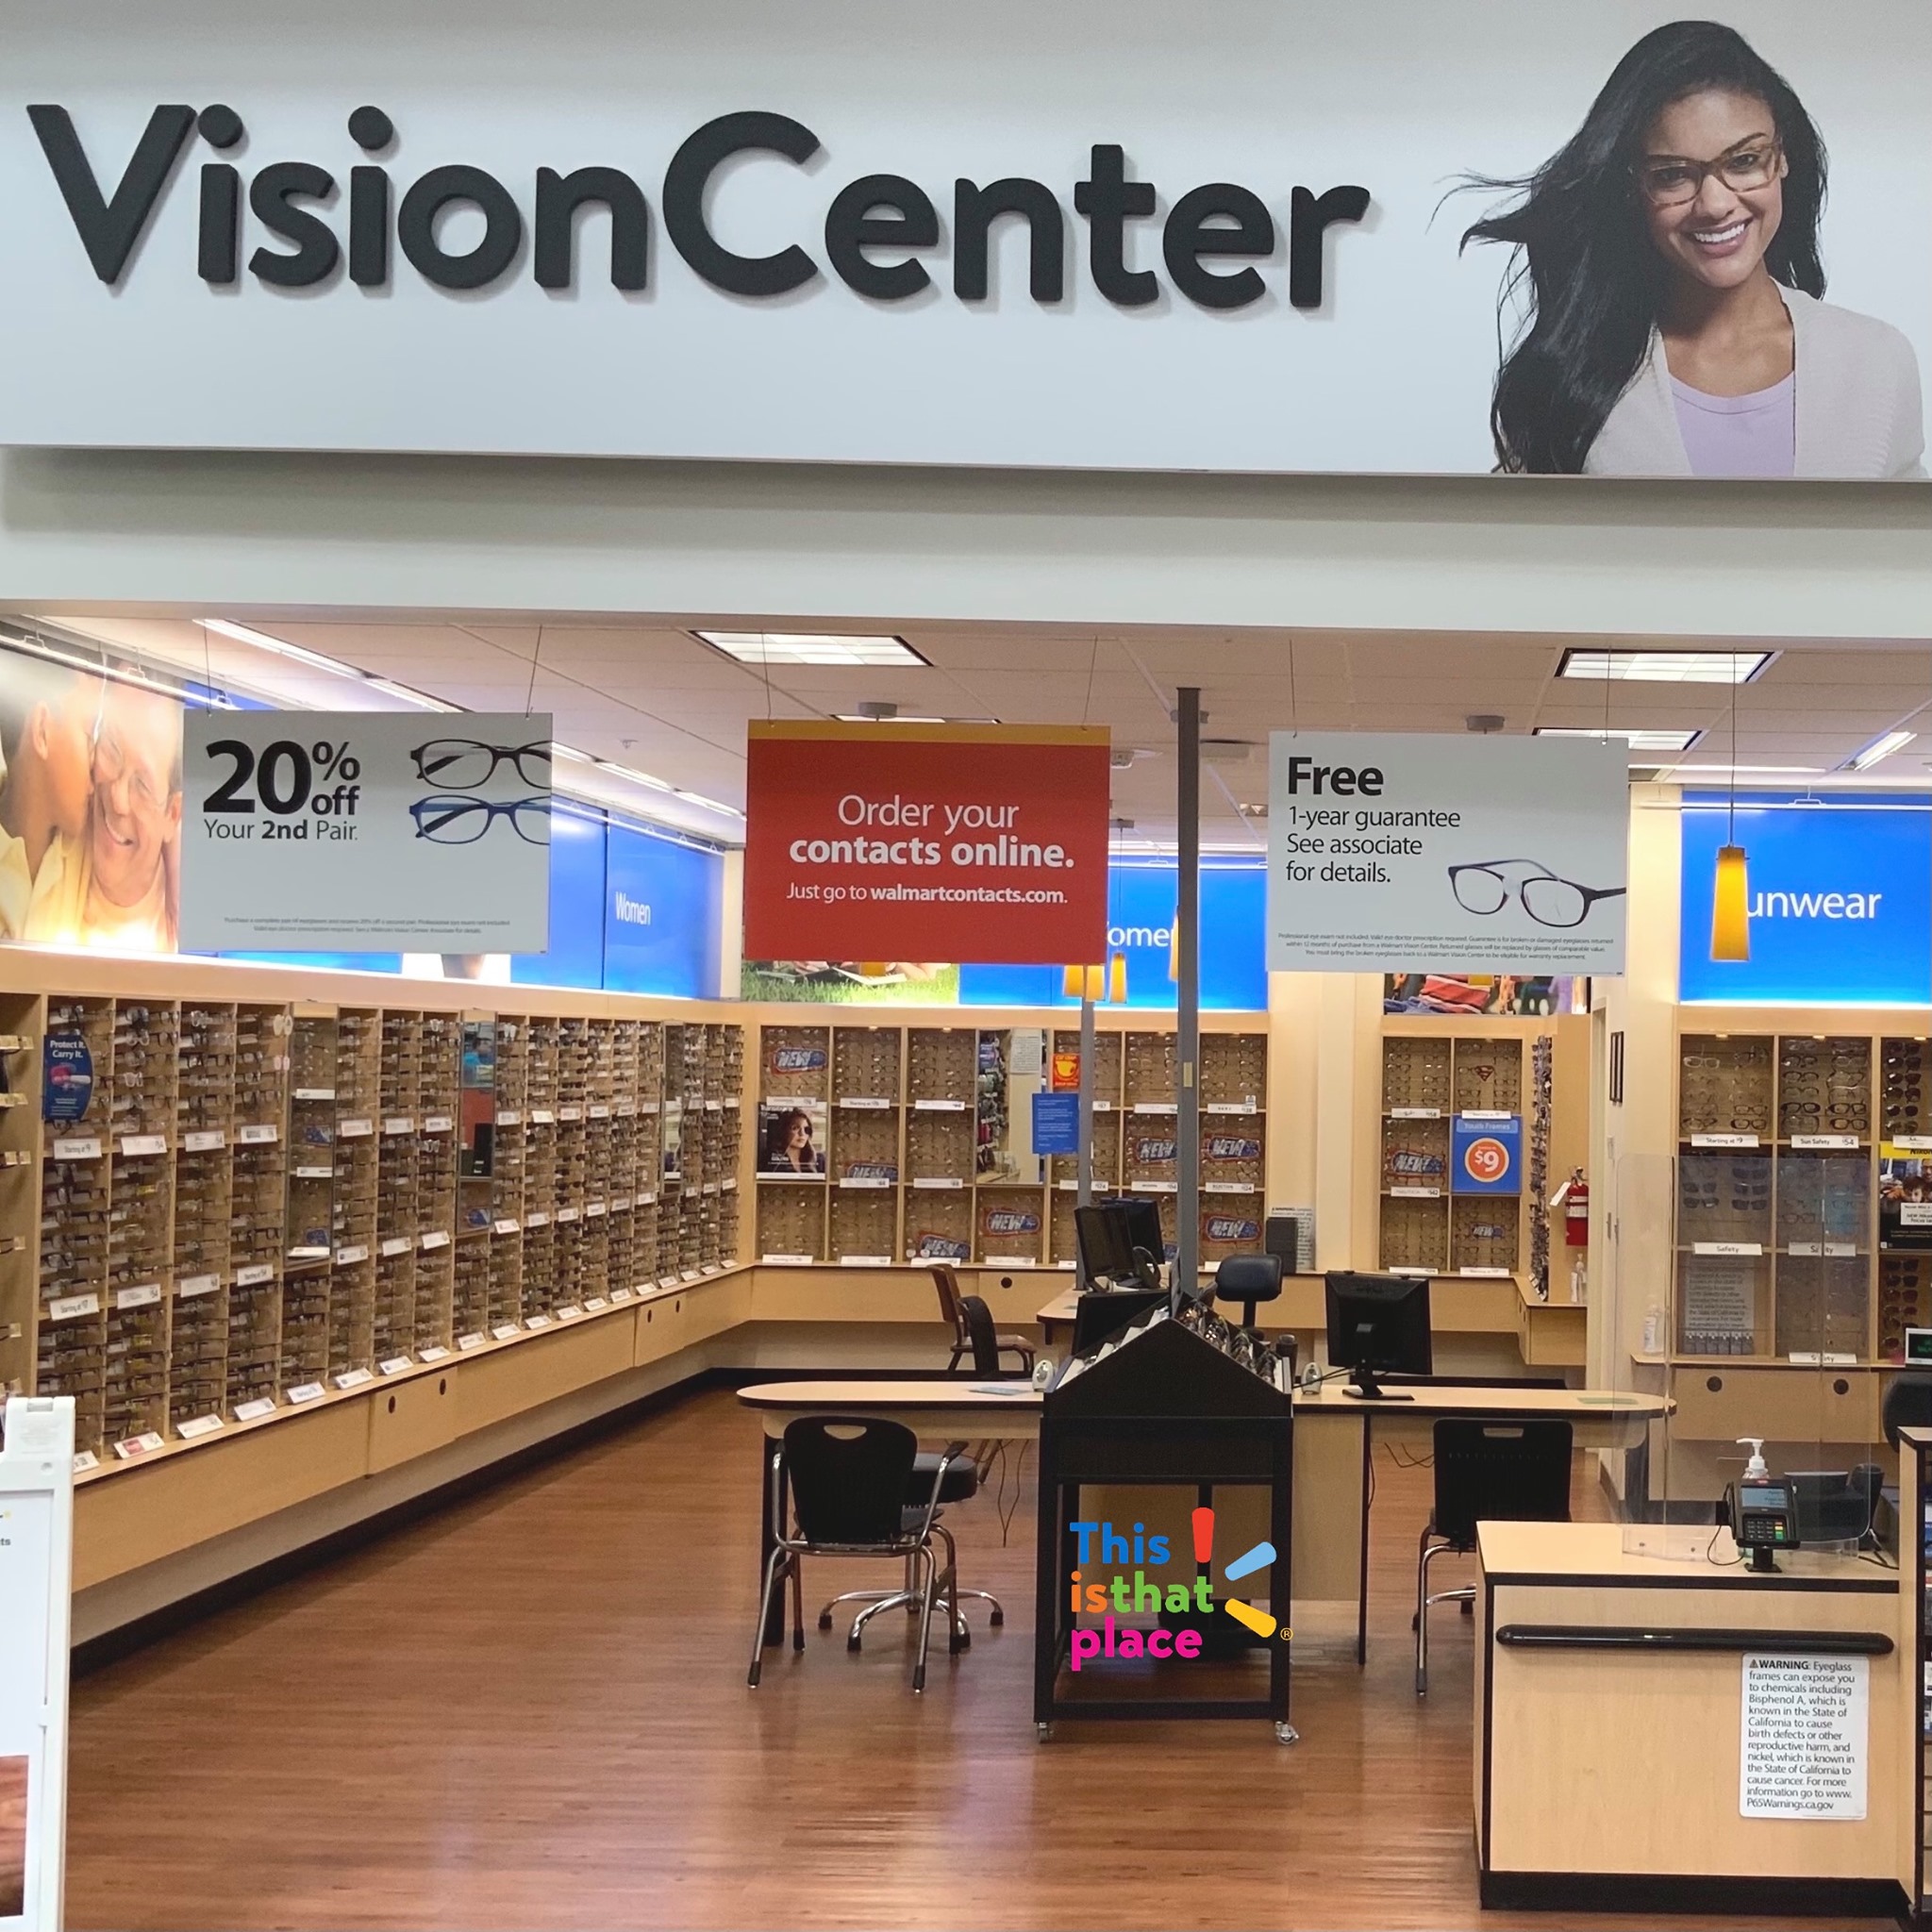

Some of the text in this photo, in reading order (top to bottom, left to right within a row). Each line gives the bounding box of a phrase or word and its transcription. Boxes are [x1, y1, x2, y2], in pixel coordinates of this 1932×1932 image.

[1288, 757, 1384, 795] Free
[311, 785, 360, 815] off
[838, 795, 1019, 836] Order your
[1289, 806, 1460, 831] 1-year guarantee
[204, 819, 358, 841] Your 2nd Pair.
[790, 834, 1074, 868] contacts online.
[1287, 833, 1423, 855] See associate
[1287, 860, 1391, 883] for details.
[787, 882, 1068, 904] Just go to walmartcontacts.com.
[615, 891, 651, 925] Women
[1746, 891, 1882, 920] unwear
[1108, 926, 1172, 947] ome
[50, 1040, 76, 1049] Protect
[53, 1050, 74, 1059] Carry
[777, 1051, 811, 1066] NEW
[1141, 1141, 1174, 1158] NEW
[1474, 1150, 1499, 1172] $9
[991, 1214, 1025, 1230] NEW
[1813, 1661, 1852, 1673] Eyeglass
[1749, 1672, 1780, 1681] frames
[1802, 1674, 1835, 1684] expose
[1838, 1675, 1855, 1684] you
[1761, 1684, 1807, 1693] chemicals
[1809, 1685, 1852, 1696] including
[1749, 1694, 1846, 1706] Bisphenol A, which is
[1749, 1706, 1847, 1717] known in the State of
[1748, 1718, 1791, 1727] California
[1794, 1719, 1804, 1727] to
[1748, 1728, 1771, 1739] birth
[1774, 1729, 1805, 1740] defects
[1819, 1731, 1842, 1740] other
[1748, 1741, 1850, 1752] reproductive harm, and
[1748, 1752, 1855, 1763] nickel, which is known in
[1748, 1763, 1762, 1773] the
[1765, 1764, 1787, 1774] State
[1789, 1764, 1798, 1774] of
[1799, 1765, 1840, 1774] California
[1747, 1776, 1772, 1785] cause
[1807, 1776, 1821, 1786] For
[1824, 1778, 1847, 1787] more
[1747, 1787, 1798, 1796] information
[1801, 1789, 1812, 1798] go
[1815, 1789, 1824, 1797] to
